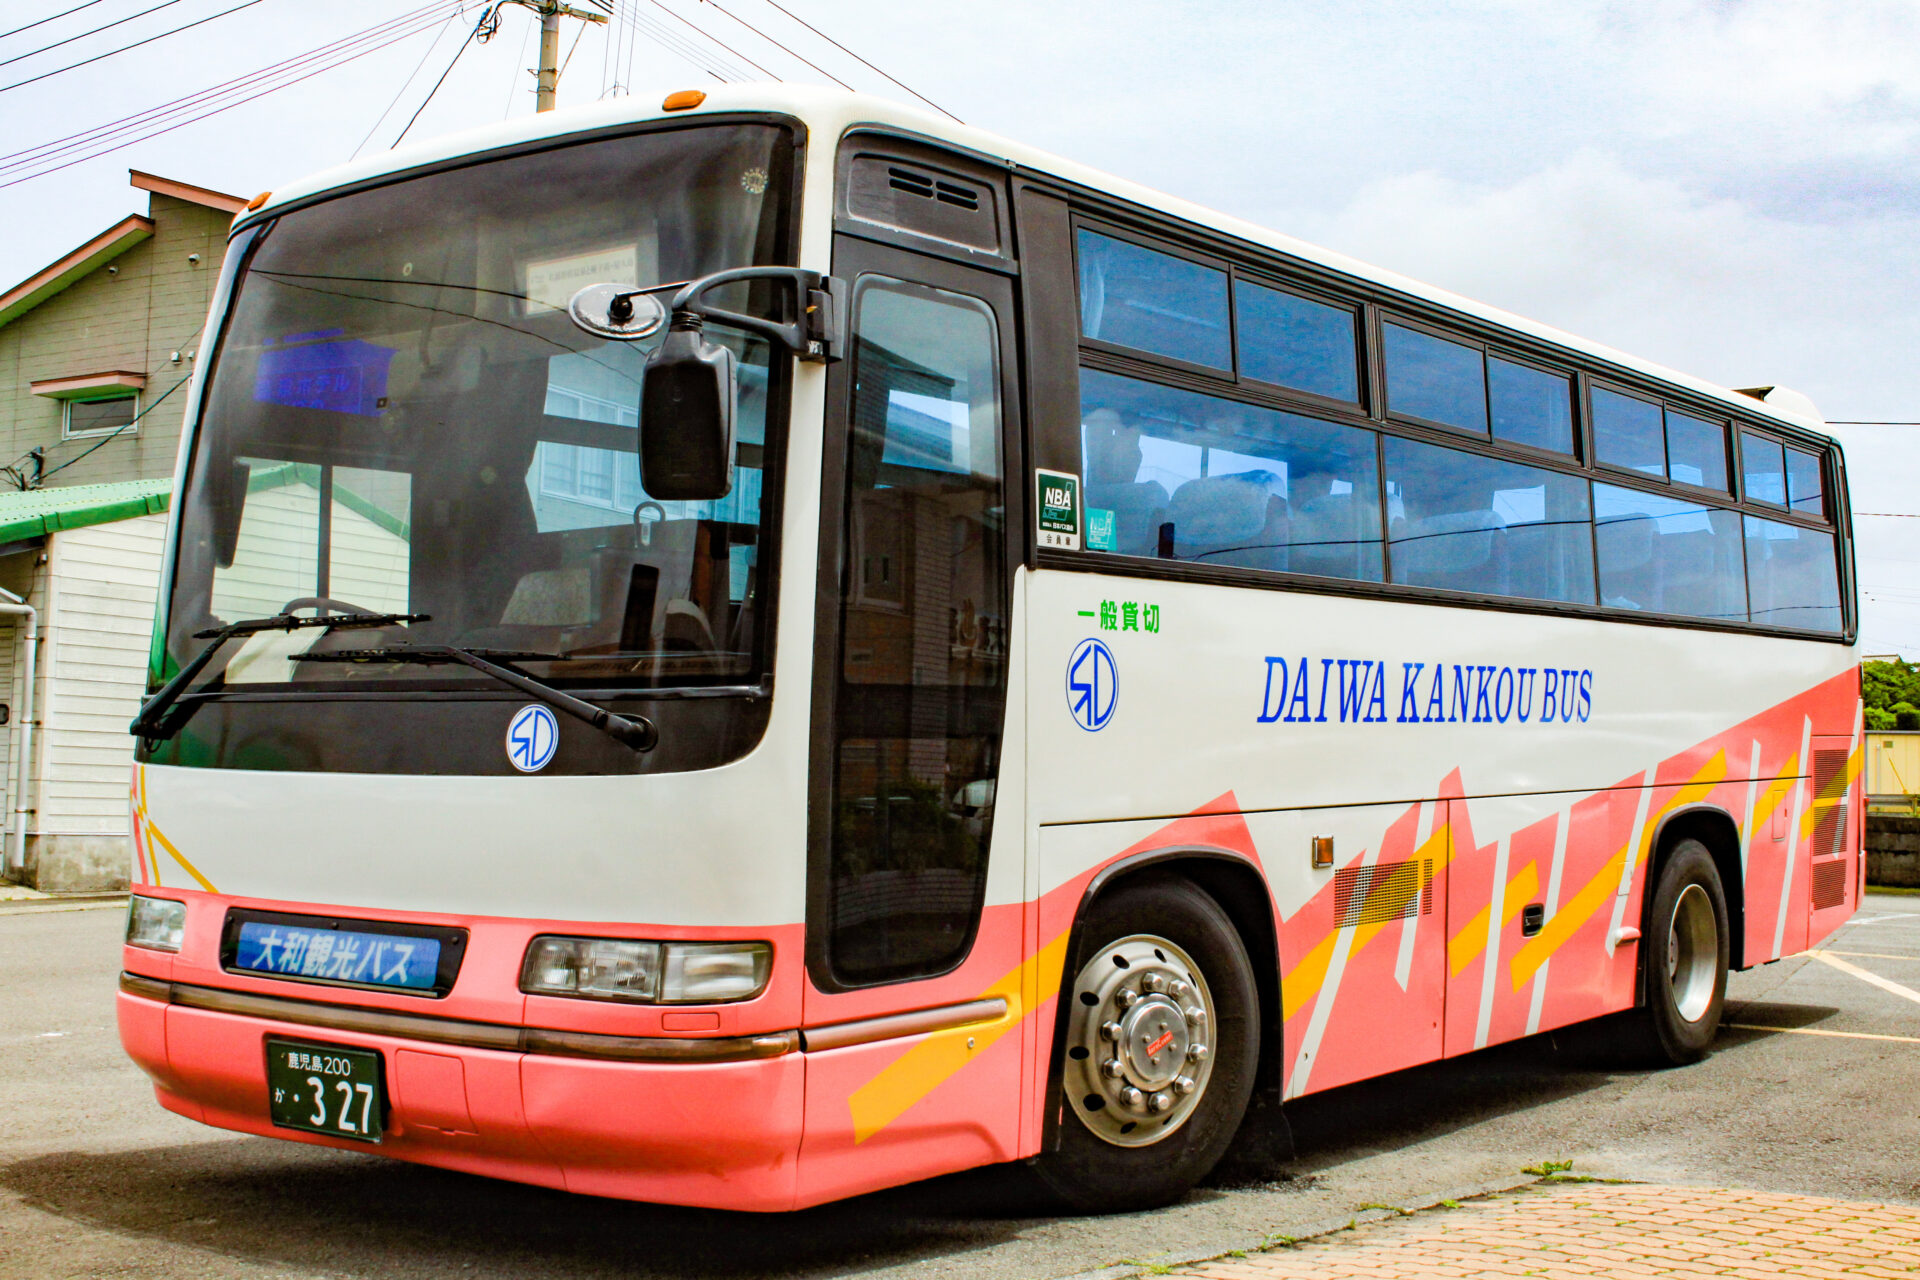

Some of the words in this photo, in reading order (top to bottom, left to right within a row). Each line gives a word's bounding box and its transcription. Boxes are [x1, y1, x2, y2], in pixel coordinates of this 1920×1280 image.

[1045, 487, 1071, 507] NBA
[1077, 599, 1160, 634] 一般貸切
[1256, 656, 1388, 723] DAIWA
[1396, 662, 1537, 724] KANKOU
[1539, 668, 1593, 723] BUS
[252, 929, 415, 984] 大和観光バス
